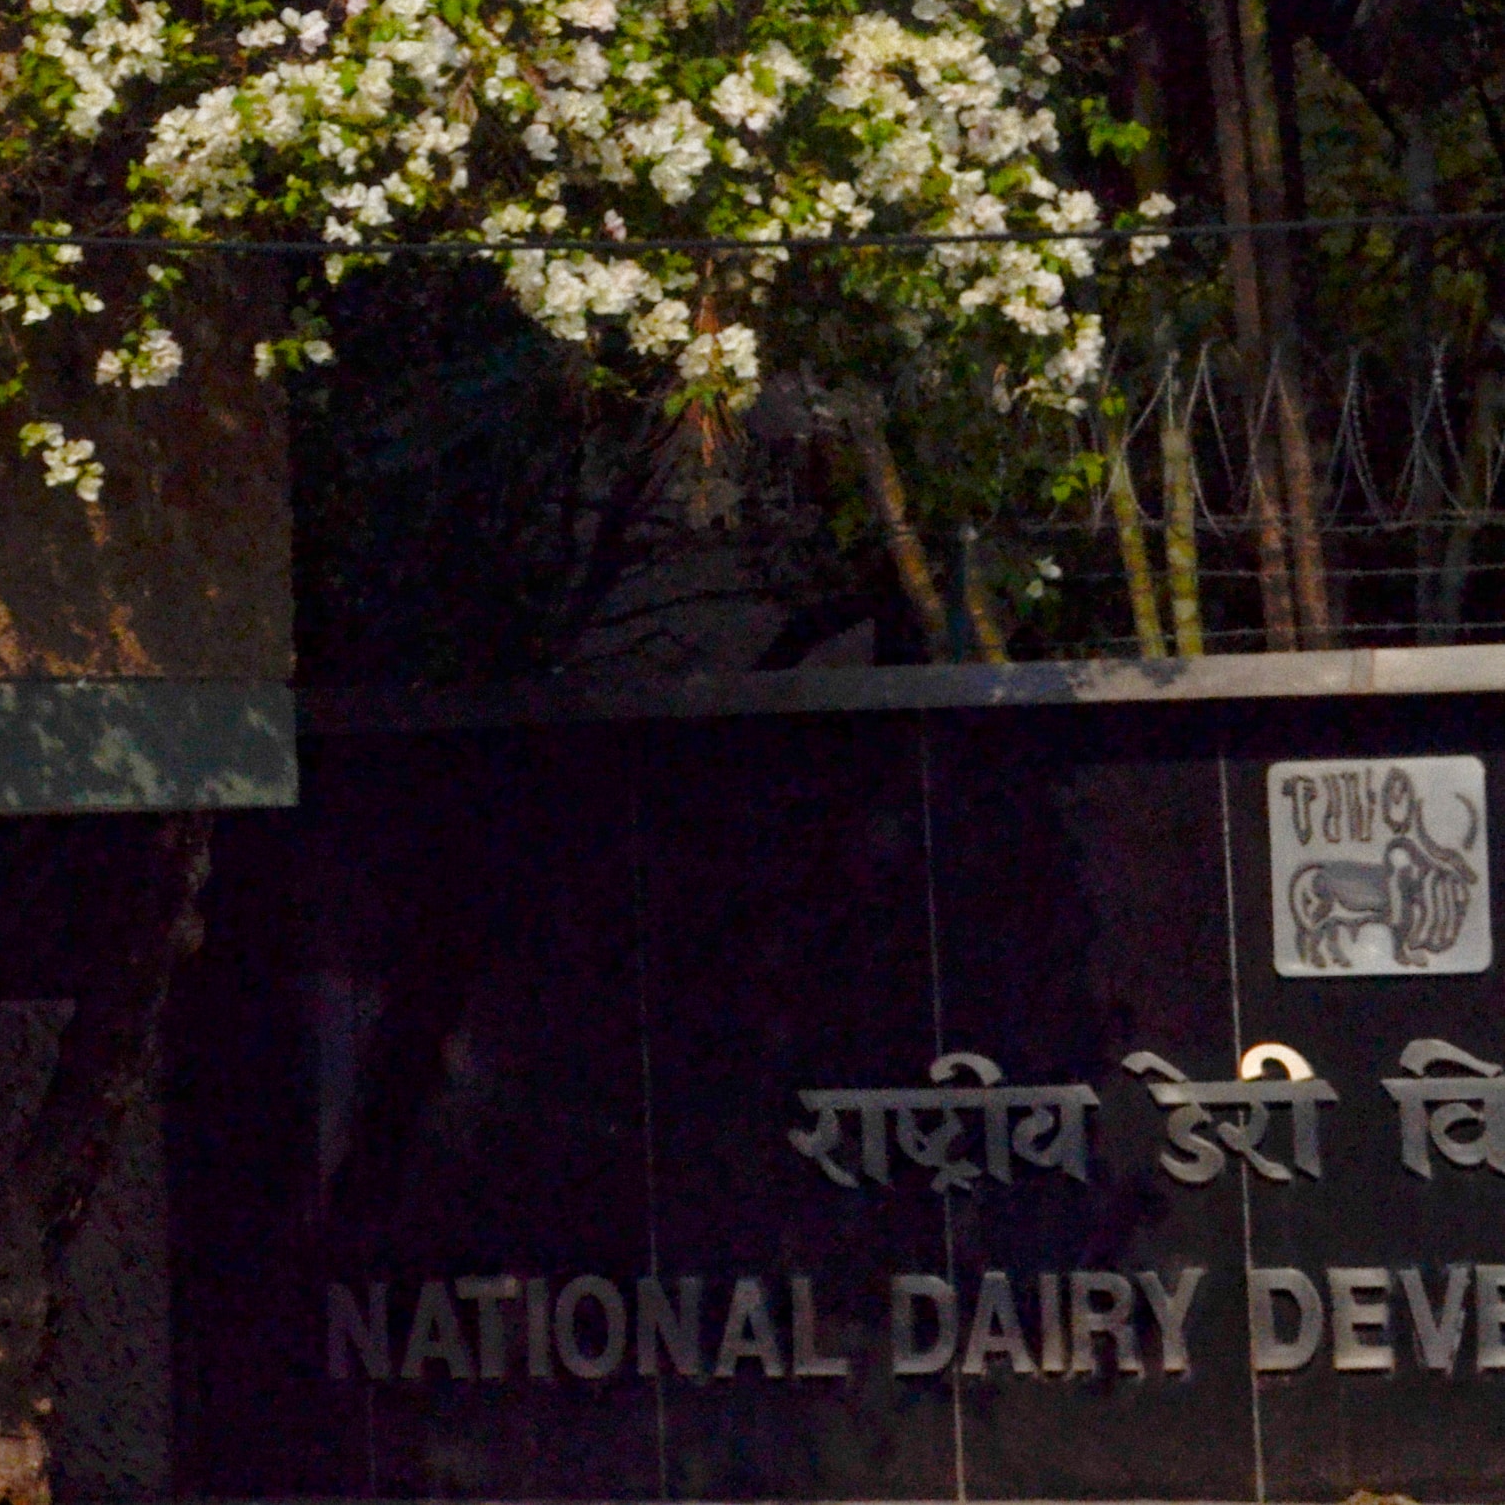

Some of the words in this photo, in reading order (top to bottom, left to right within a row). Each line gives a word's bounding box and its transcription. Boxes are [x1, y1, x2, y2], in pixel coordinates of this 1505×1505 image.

[788, 1052, 1100, 1193] राष्ट्रीय
[1121, 1042, 1339, 1183] डेरी
[326, 1275, 849, 1379] NATIONAL
[893, 1267, 1203, 1377] DAIRY
